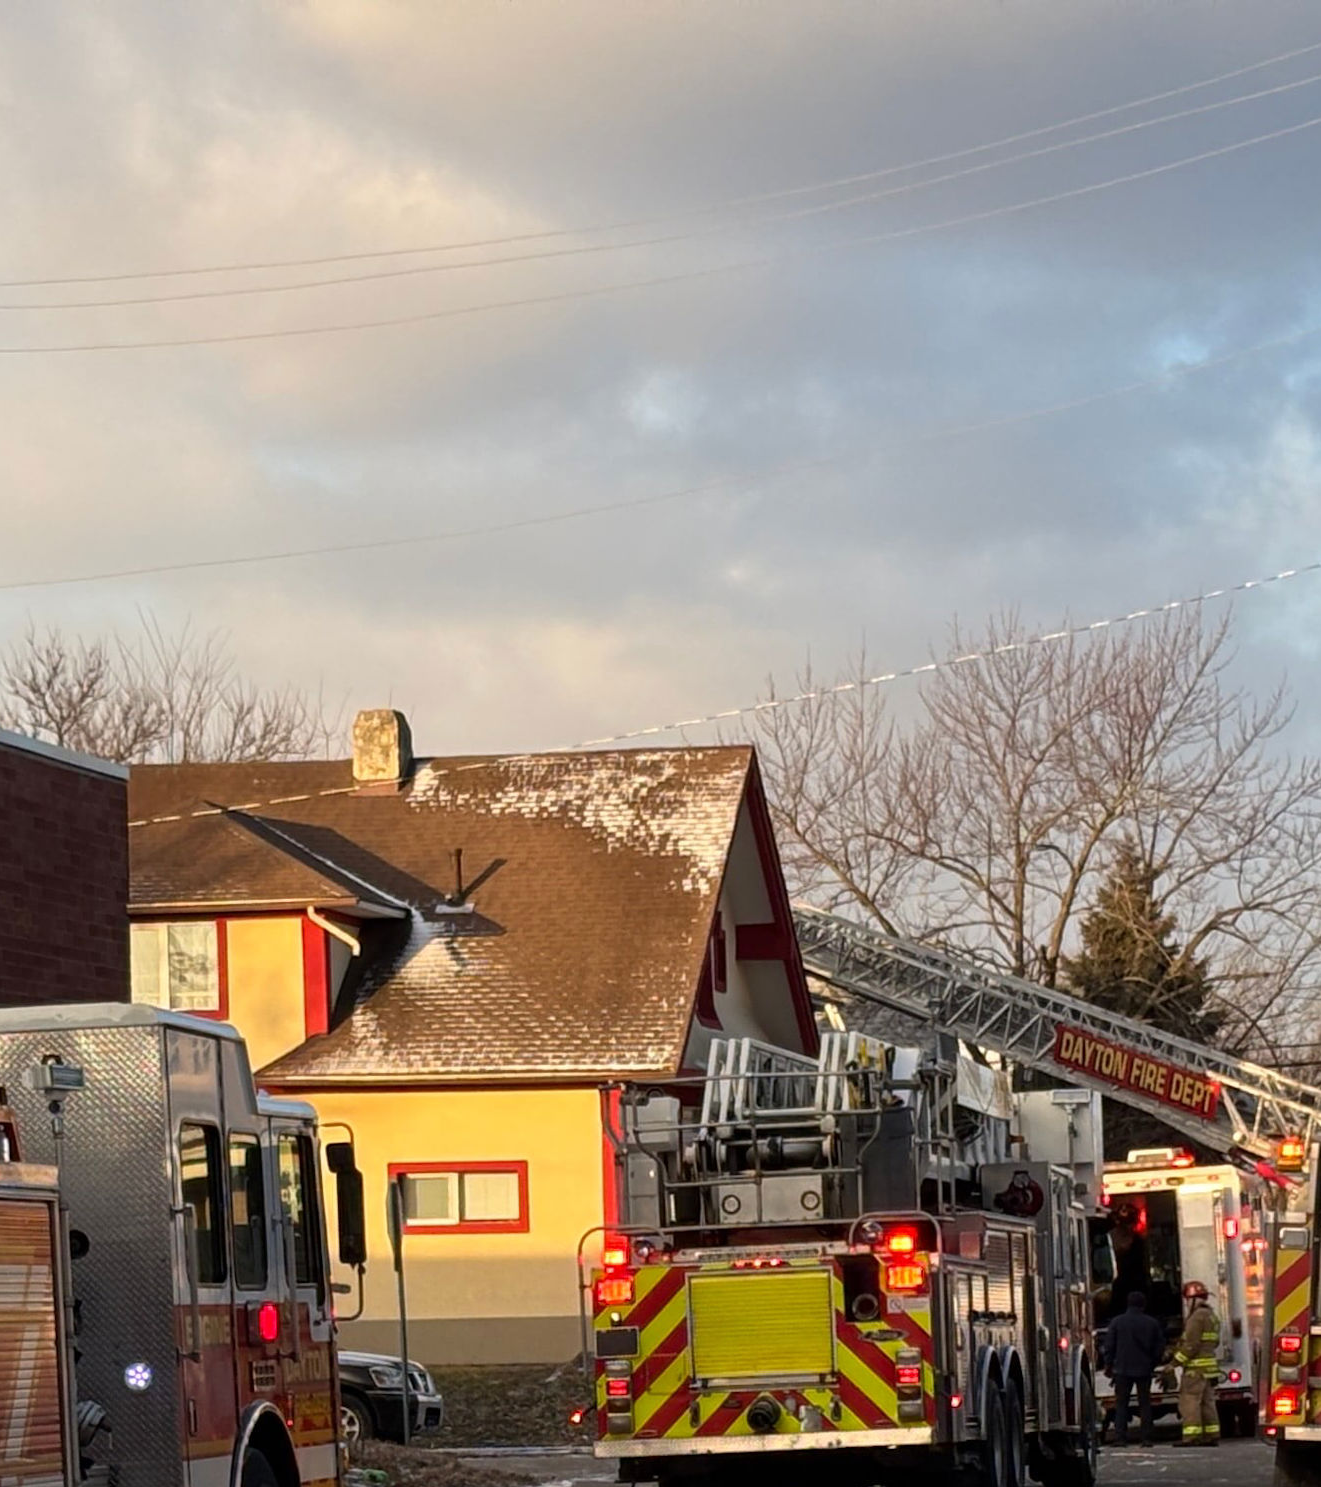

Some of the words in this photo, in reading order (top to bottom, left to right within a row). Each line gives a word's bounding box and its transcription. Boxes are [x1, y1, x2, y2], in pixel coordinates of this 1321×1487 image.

[1060, 1032, 1128, 1080] DAYTON
[1130, 1057, 1167, 1094] FIRE
[1170, 1072, 1215, 1113] DEPT
